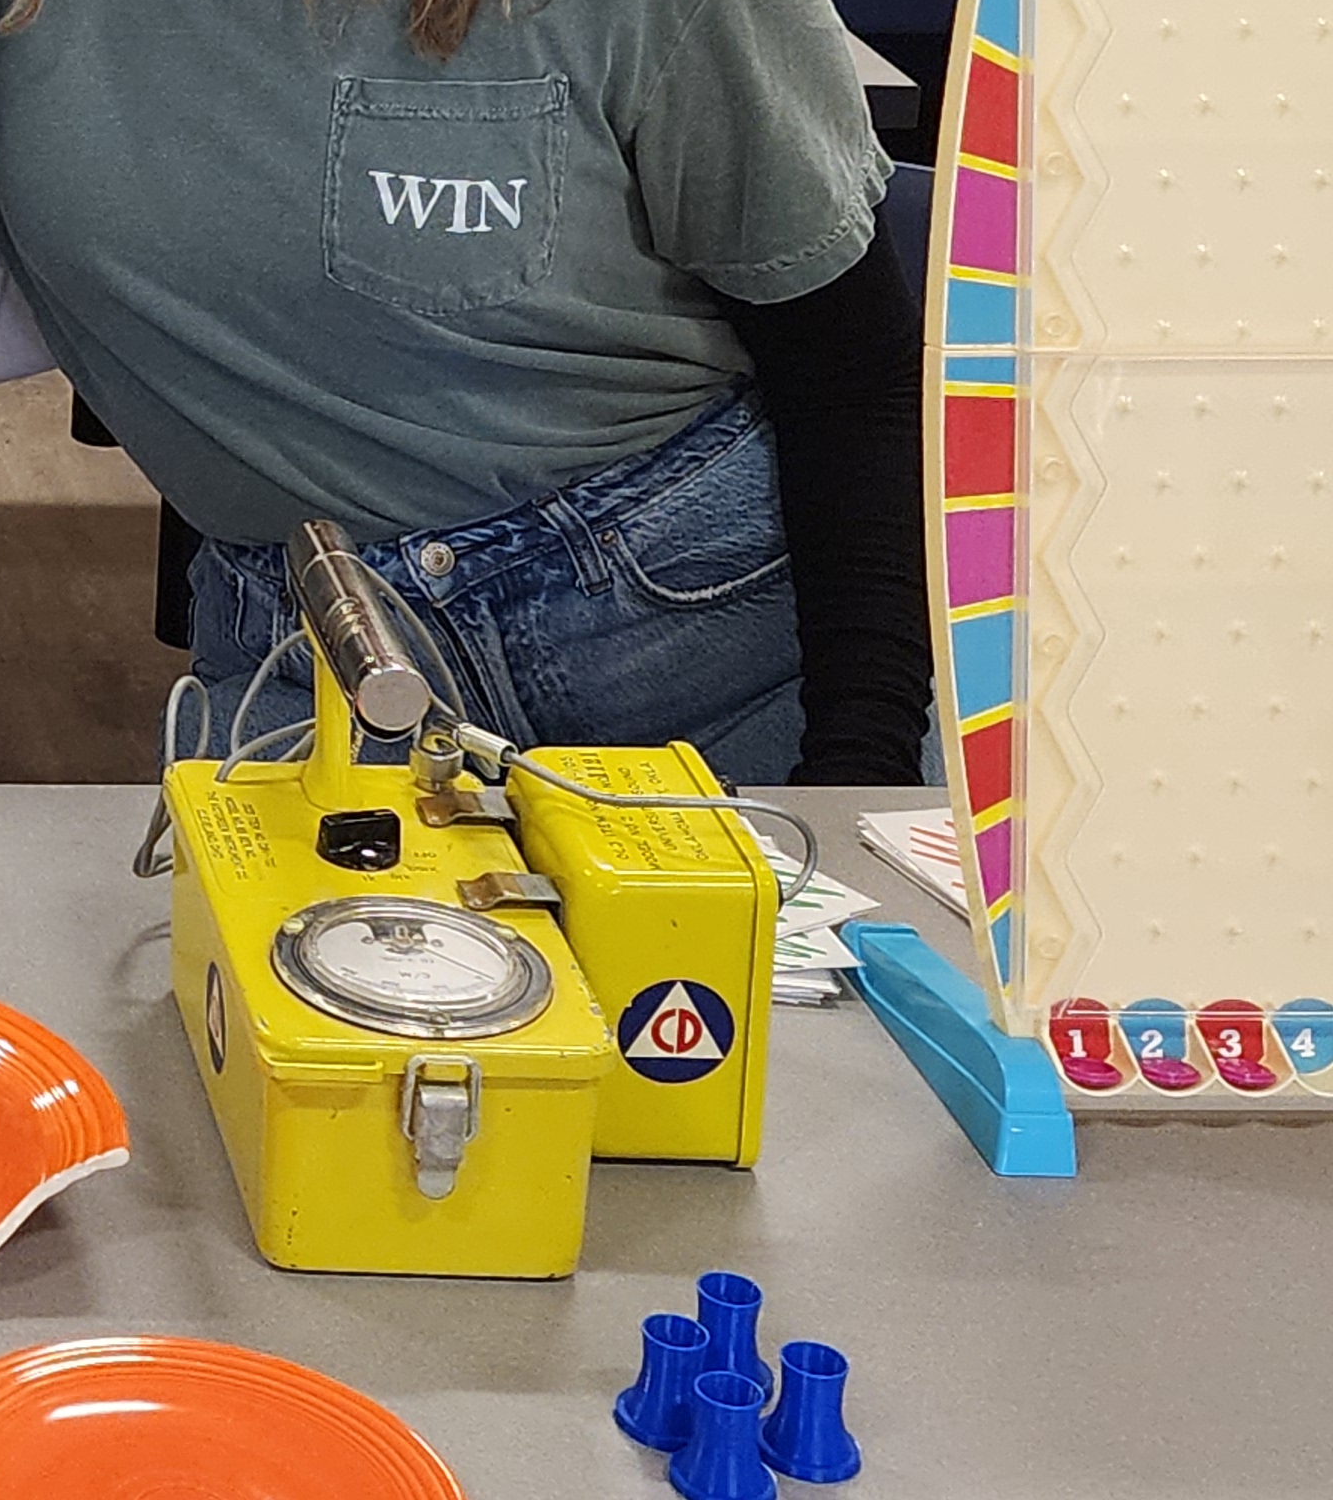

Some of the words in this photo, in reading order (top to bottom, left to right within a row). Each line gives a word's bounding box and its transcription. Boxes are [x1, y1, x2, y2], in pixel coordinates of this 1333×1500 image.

[368, 170, 529, 234] WIN
[650, 1007, 704, 1053] CD
[1067, 1029, 1088, 1058] 1
[1140, 1029, 1165, 1059] 2
[1217, 1029, 1242, 1058] 3
[1290, 1028, 1316, 1058] 4
